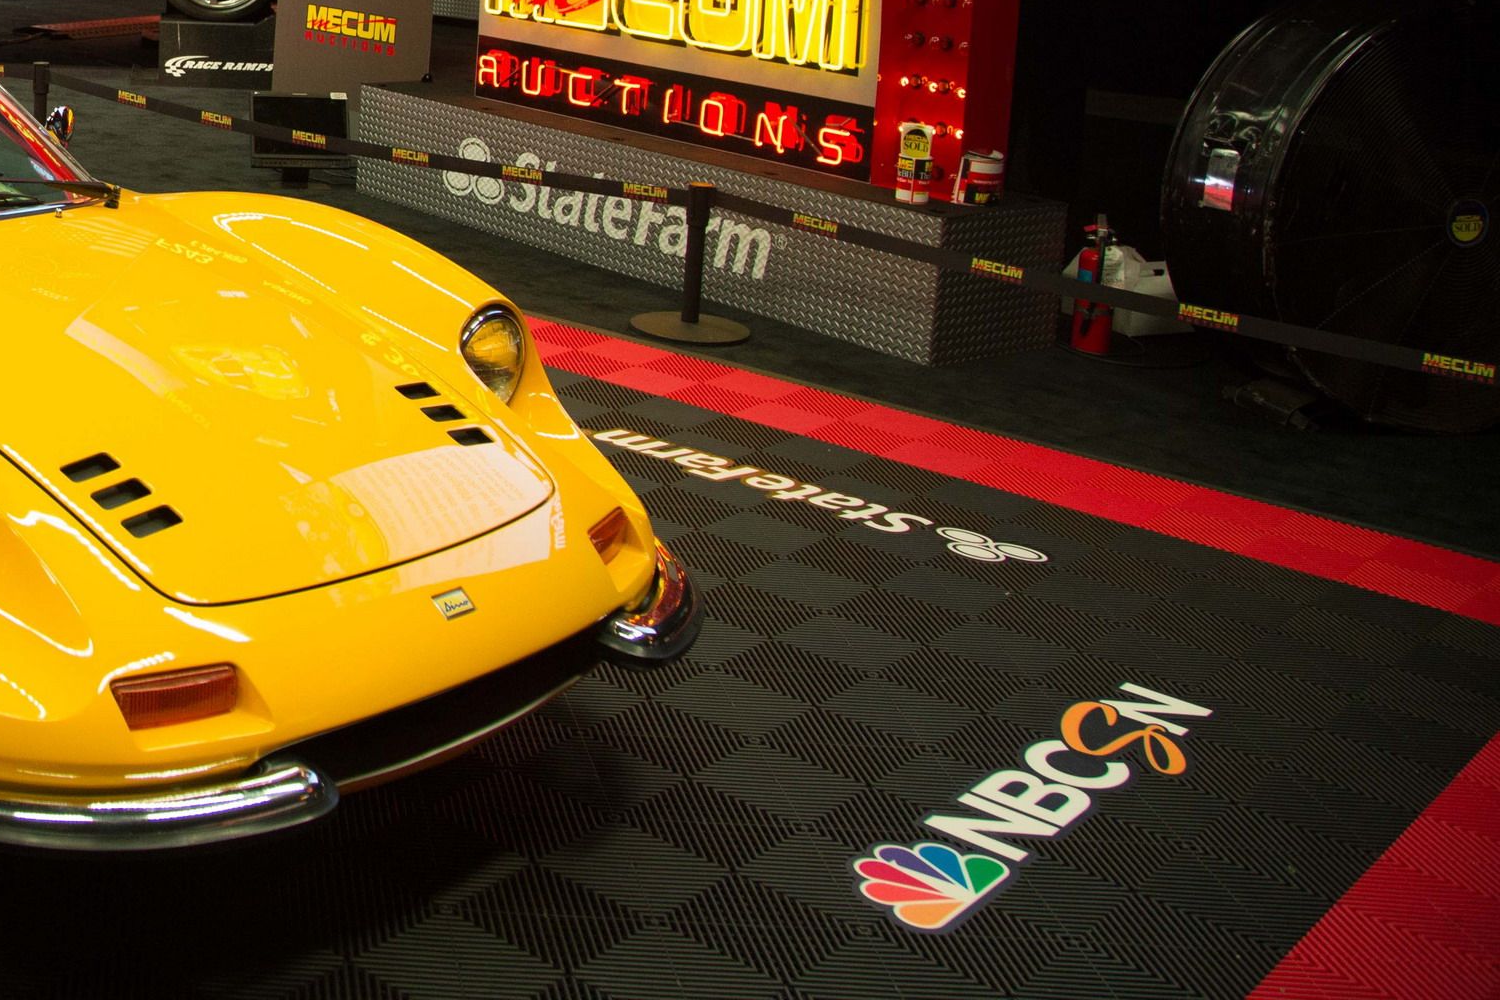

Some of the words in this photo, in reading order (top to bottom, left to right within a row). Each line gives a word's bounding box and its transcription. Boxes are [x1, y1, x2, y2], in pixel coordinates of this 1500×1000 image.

[306, 4, 397, 44] MECUM
[304, 31, 396, 56] AUCTIONS
[184, 60, 221, 70] RACE
[223, 62, 274, 72] RAMPS
[118, 90, 146, 104] MECUM
[478, 50, 862, 166] AUCTIONS
[201, 111, 232, 126] MECUM
[293, 130, 326, 145] MECUM
[393, 148, 429, 163] MECUM
[502, 166, 542, 180] MECUM
[623, 183, 667, 199] MECUM
[793, 213, 838, 233] MECUM
[971, 257, 1023, 279] MECUM
[1179, 303, 1239, 326] MECUM
[1423, 352, 1495, 378] MECUM
[923, 682, 1213, 862] NBCSN
